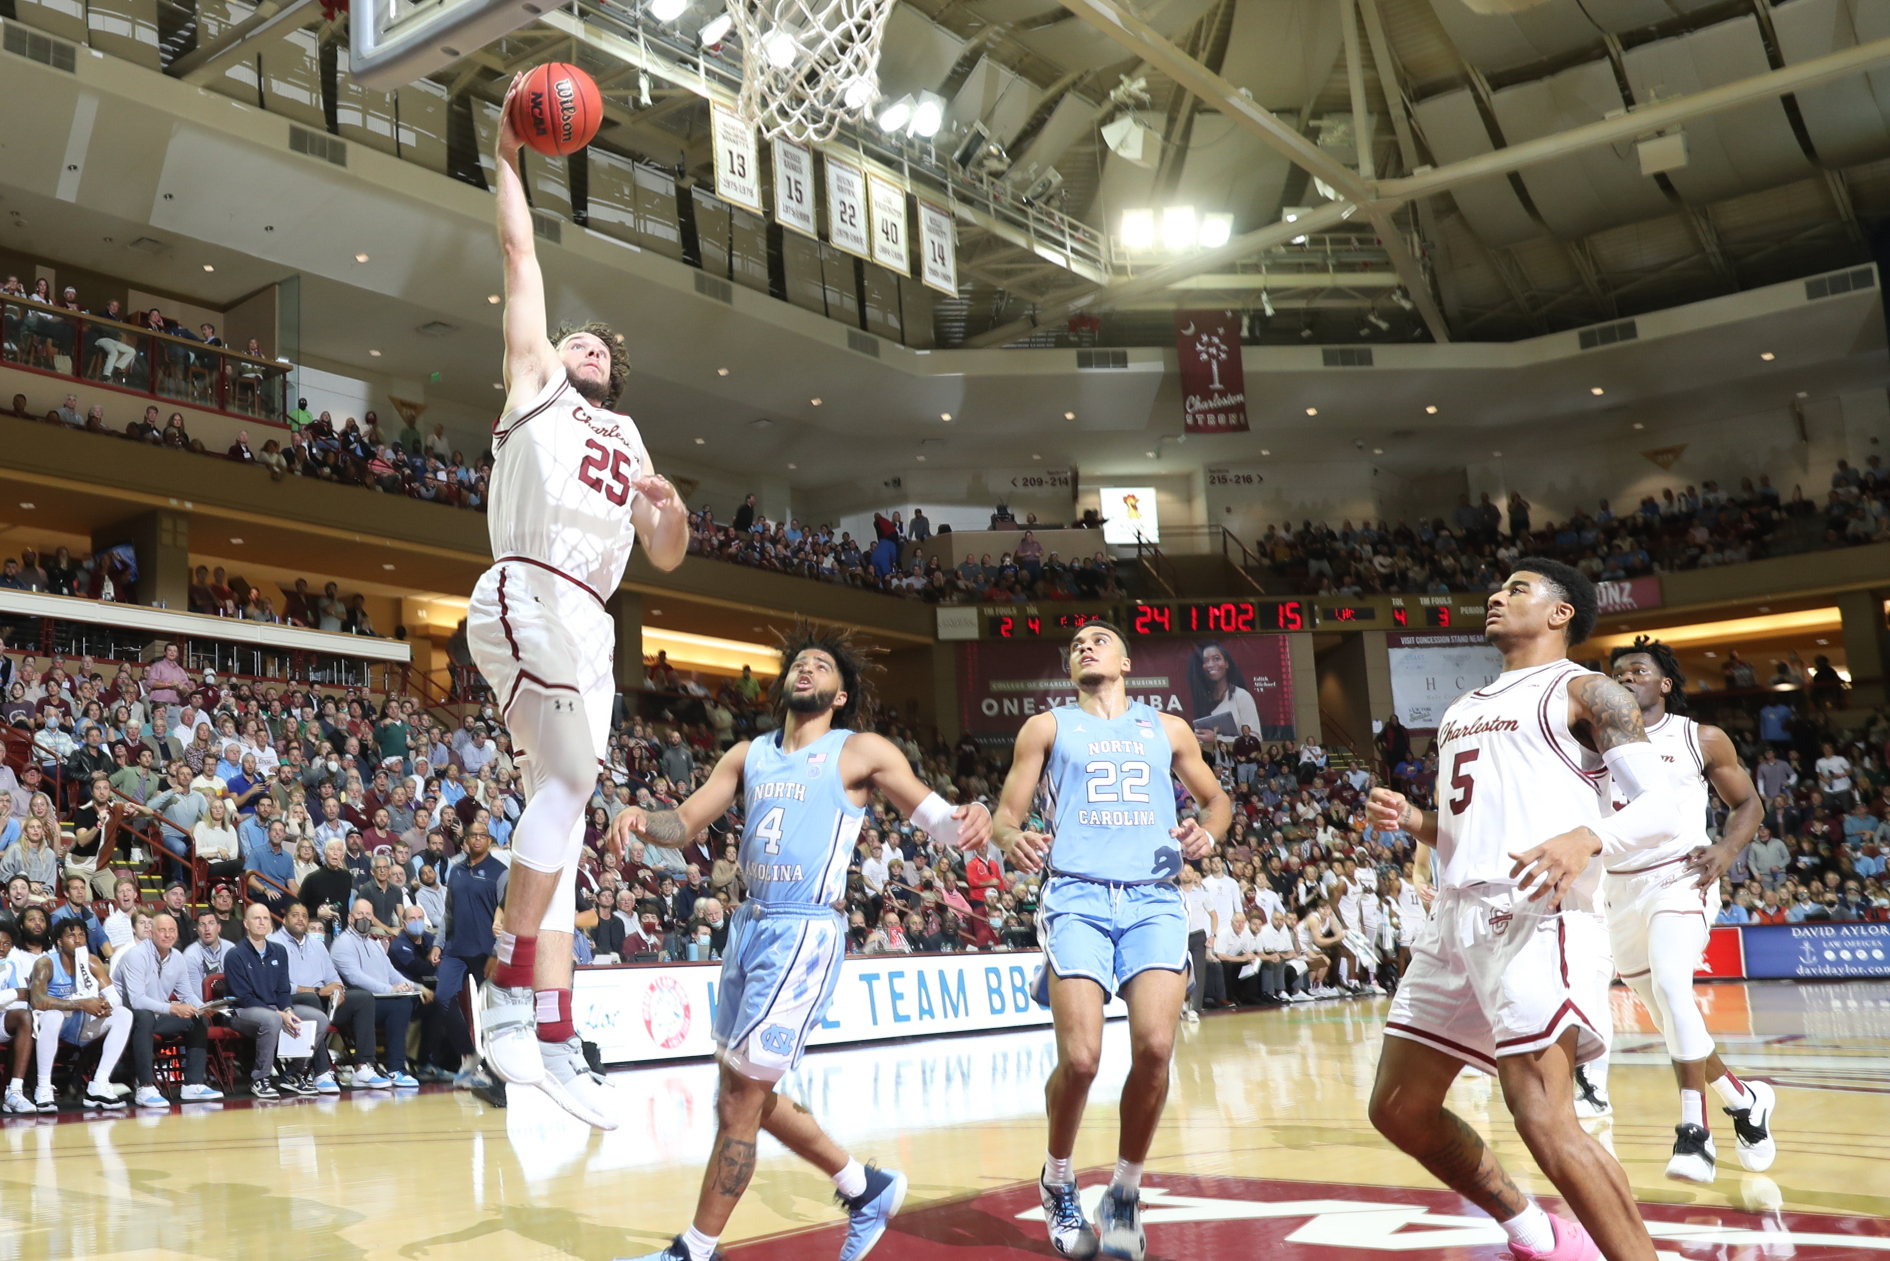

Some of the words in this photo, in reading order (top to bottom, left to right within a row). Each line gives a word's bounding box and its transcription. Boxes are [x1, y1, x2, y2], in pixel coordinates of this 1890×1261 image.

[530, 91, 548, 137] NCAA
[554, 77, 578, 143] Wilson
[727, 149, 746, 179] 13
[785, 174, 804, 205] 15
[839, 200, 857, 229] 22
[881, 216, 898, 246] 40
[930, 239, 947, 268] 14
[1185, 392, 1245, 414] Charleston
[577, 438, 631, 507] 25
[1391, 598, 1404, 606] TOL
[1420, 597, 1431, 606] TM
[1431, 597, 1453, 606] FOULS
[1460, 606, 1485, 615] PERIOD
[1000, 616, 1013, 637] 2
[1027, 616, 1041, 636] 4
[1135, 604, 1171, 634] 24
[1278, 601, 1303, 631] 15
[1393, 608, 1407, 627] 4
[1438, 607, 1450, 627] 3
[1400, 636, 1415, 645] VISIT
[1415, 635, 1450, 645] CONCESSION
[1451, 635, 1469, 643] STAND
[1469, 634, 1485, 643] NEAR
[992, 682, 1024, 690] COLLEGE
[1131, 679, 1167, 687] BUSINESS
[981, 696, 1078, 717] ONE-YE
[1133, 695, 1184, 713] MBA
[1438, 715, 1519, 749] Charleston
[1088, 740, 1146, 756] NORTH
[754, 781, 807, 802] NORTH
[1085, 760, 1151, 803] 22
[1449, 748, 1480, 816] 5
[1078, 809, 1156, 826] CAROLINA
[755, 806, 786, 856] 4
[1791, 926, 1837, 938] DAVID
[1840, 925, 1890, 937] AYLOR
[1822, 940, 1842, 948] LAW
[1843, 939, 1884, 948] OFFICES
[859, 968, 970, 1027] TEAM
[985, 965, 1050, 1015] BB
